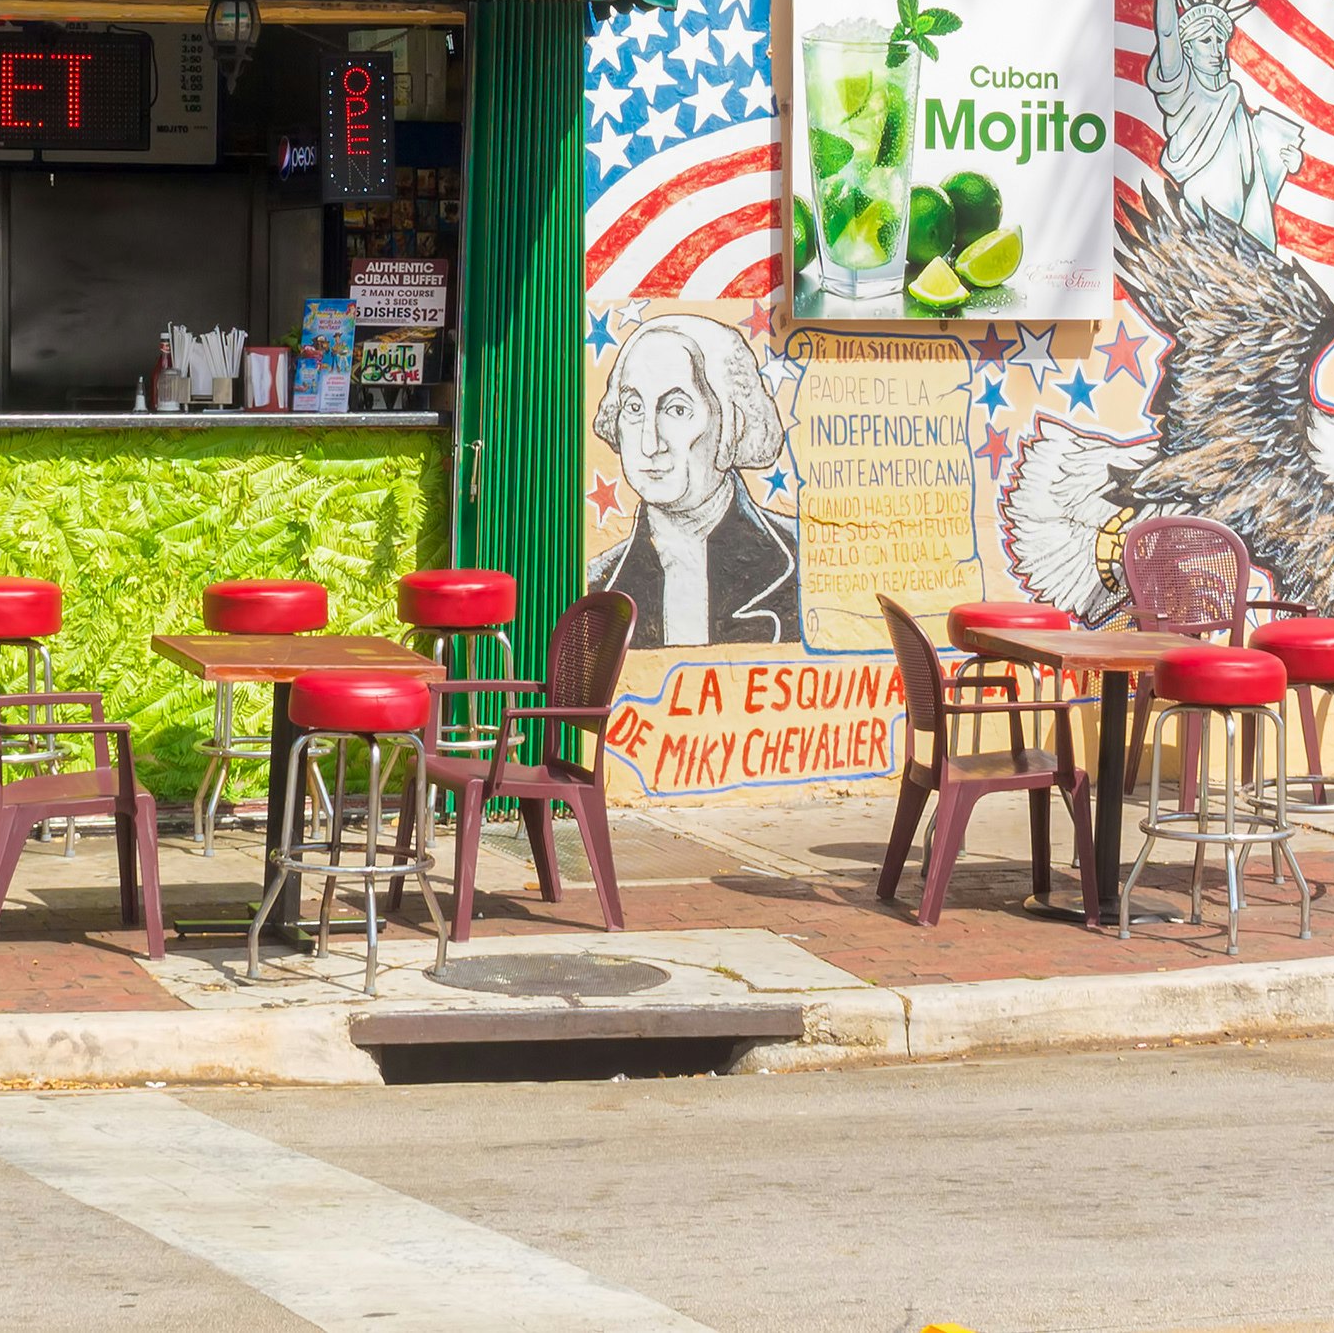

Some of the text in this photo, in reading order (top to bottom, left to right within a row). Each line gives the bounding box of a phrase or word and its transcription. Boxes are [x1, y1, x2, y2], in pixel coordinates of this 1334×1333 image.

[970, 65, 1059, 90] Cuban
[343, 67, 371, 186] OPEN
[925, 98, 1107, 165] Mojito
[354, 274, 444, 285] CUBAN BUFFET
[366, 262, 434, 273] AUTHENTIC
[361, 289, 367, 297] 2
[397, 289, 435, 297] COURSE
[385, 298, 418, 306] 3 SIDES
[364, 307, 411, 318] DISHES
[835, 339, 961, 364] WASHINGTON
[810, 375, 930, 406] PADRE DE LA
[810, 414, 967, 447] INDEPENDENCIA
[808, 458, 972, 490] NORTEAMERICANA
[864, 493, 910, 517] HABLES
[914, 491, 932, 515] DE
[936, 491, 969, 515] DIOS
[822, 524, 840, 544] DE
[847, 520, 880, 543] SUS
[808, 545, 859, 567] HAZLO
[865, 543, 888, 565] CON
[933, 541, 952, 561] LA
[872, 571, 881, 591] Y
[668, 668, 723, 716] LA
[744, 665, 907, 716] ESQUINA
[605, 706, 890, 791] DE MIKY CHEVALIER
